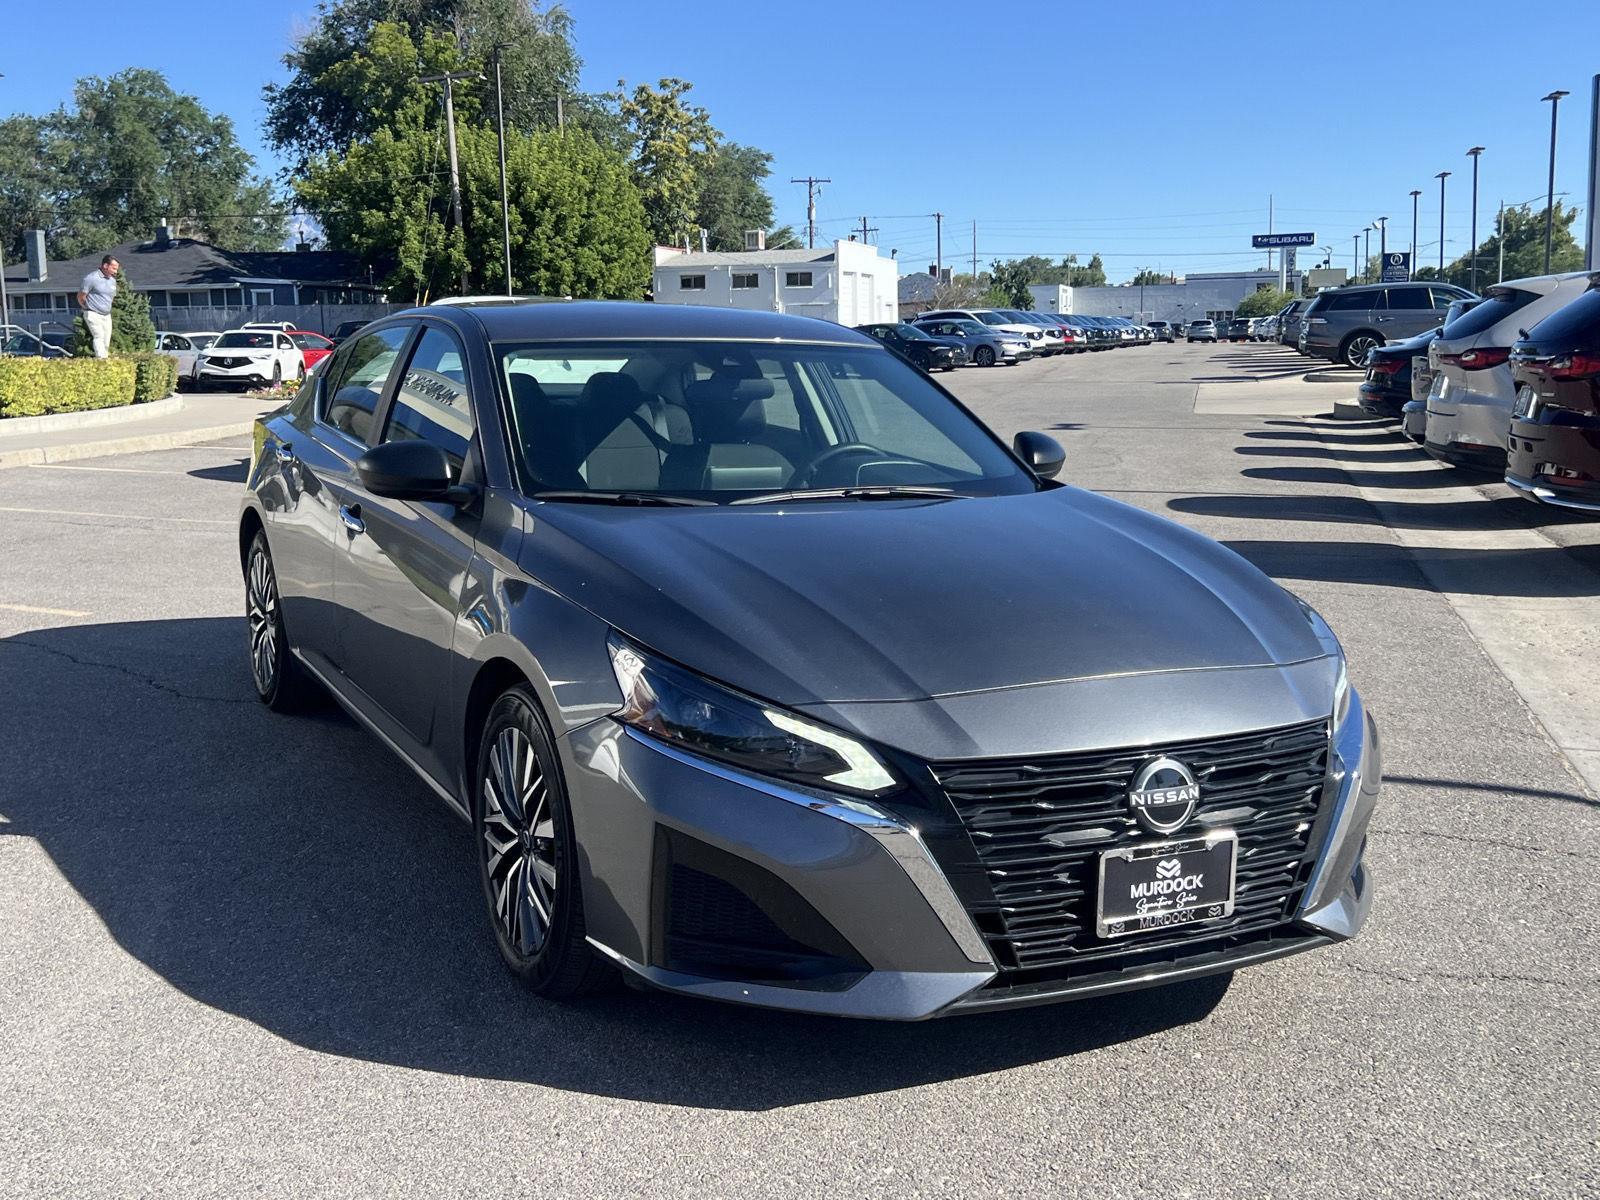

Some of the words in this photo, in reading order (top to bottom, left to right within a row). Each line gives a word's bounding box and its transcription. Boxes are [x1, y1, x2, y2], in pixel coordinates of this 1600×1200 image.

[1269, 235, 1313, 244] SUBARU
[1131, 786, 1199, 805] NISSAN
[1130, 874, 1203, 899] MURDOCK
[1139, 909, 1195, 929] MURDOCK
